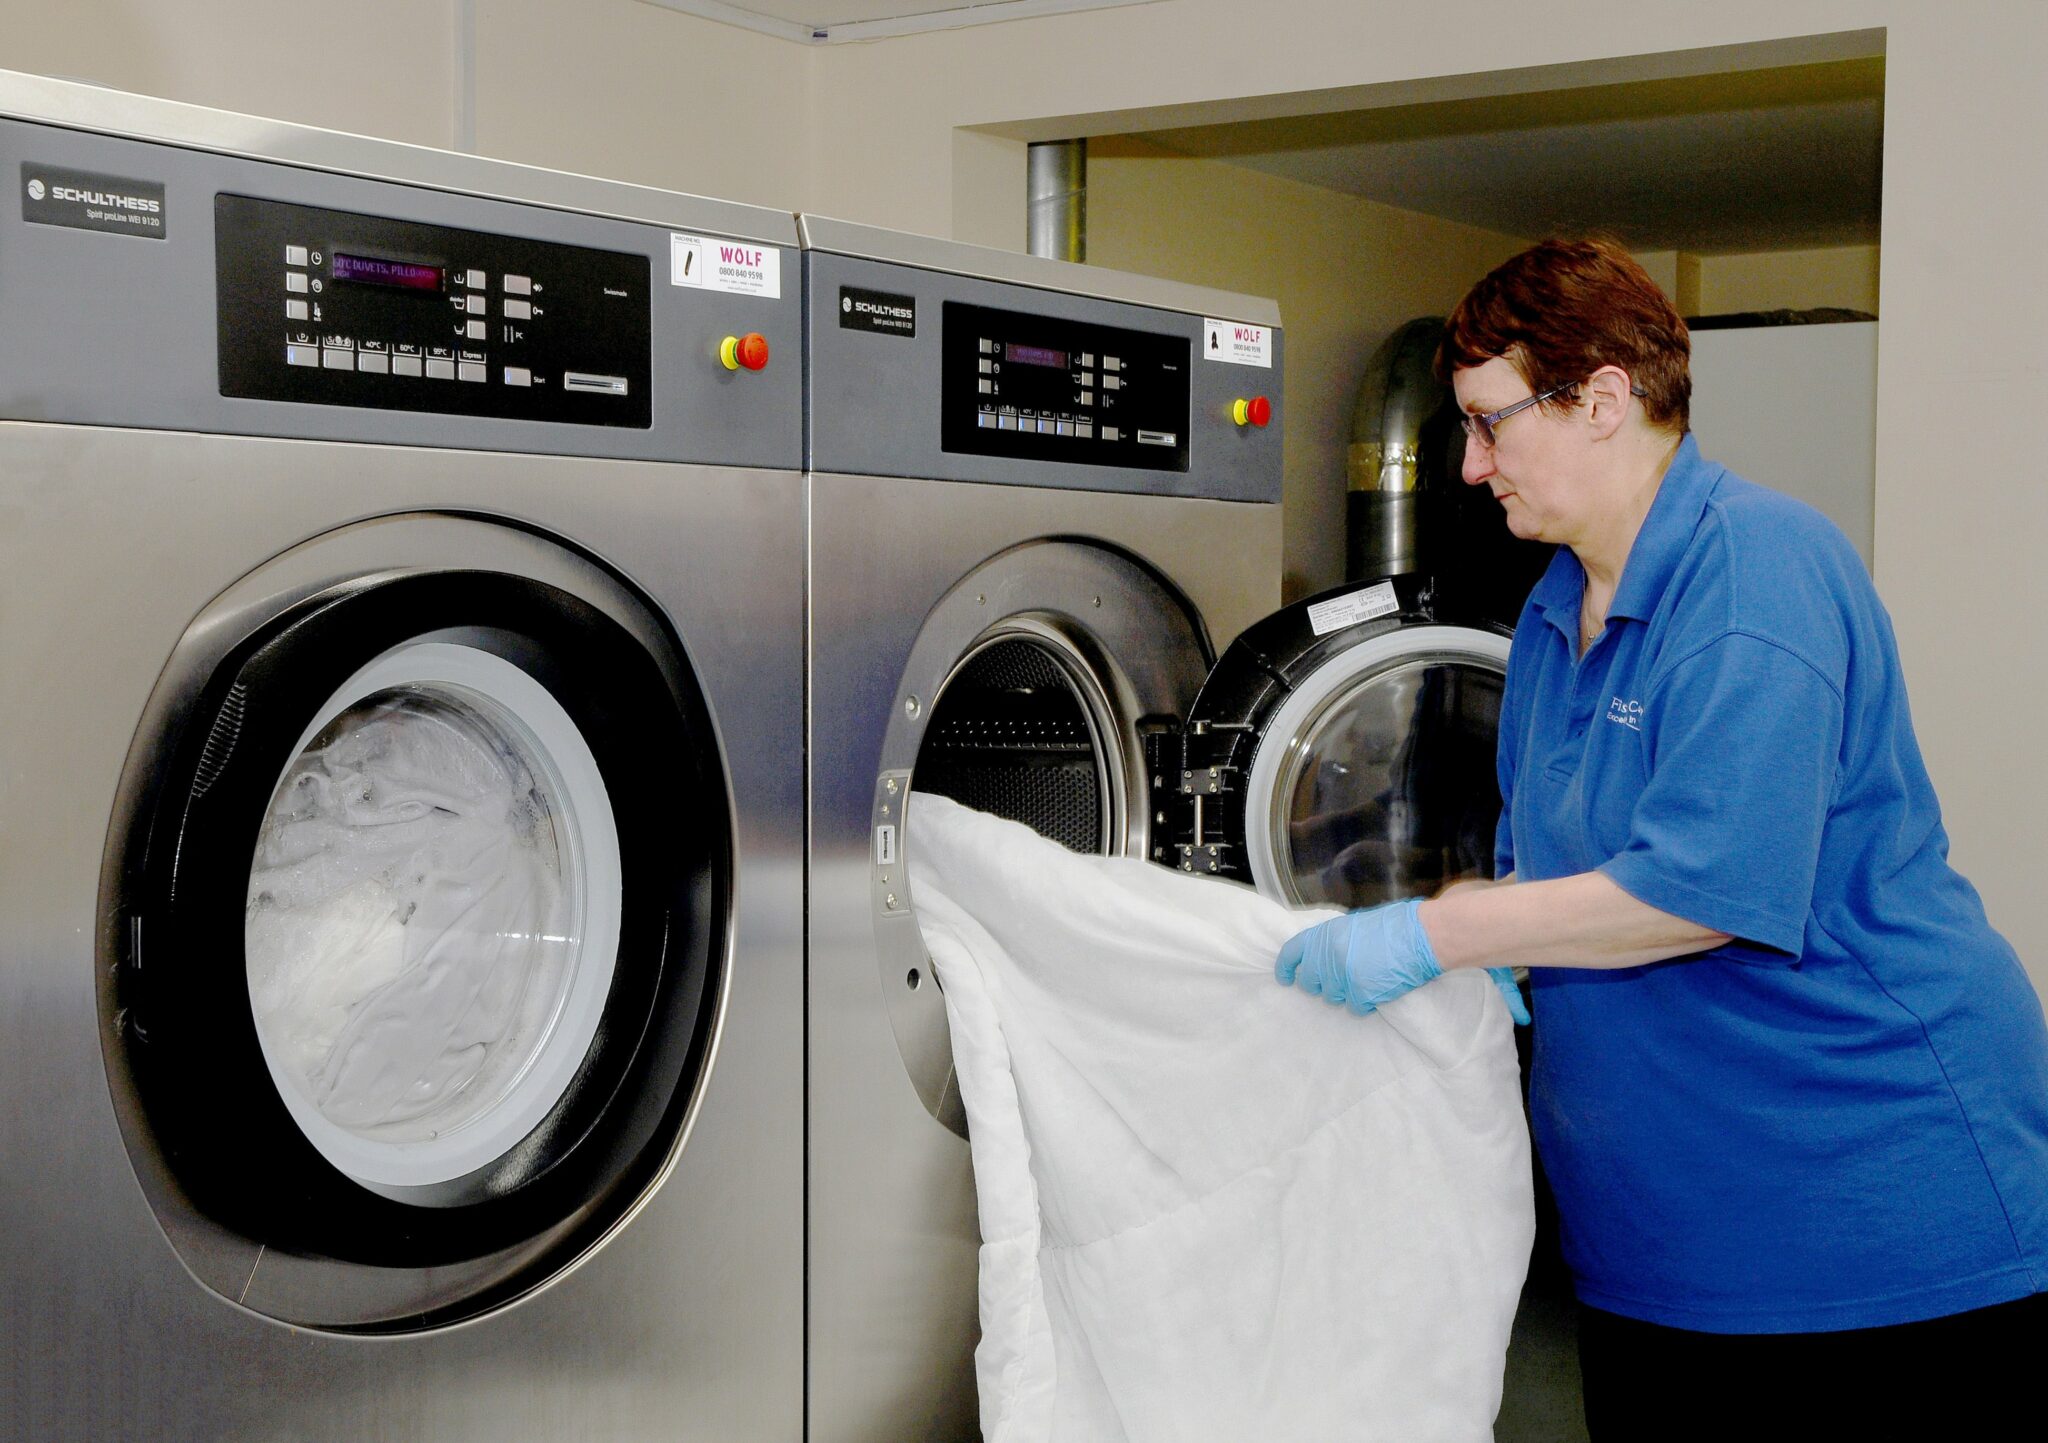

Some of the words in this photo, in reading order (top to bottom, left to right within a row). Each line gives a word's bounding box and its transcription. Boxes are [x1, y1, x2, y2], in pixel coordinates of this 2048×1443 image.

[52, 186, 160, 213] SCHULTHESS
[86, 208, 103, 220] Spirit
[104, 211, 127, 223] proLine
[128, 214, 141, 224] WEI
[141, 216, 160, 226] 9120
[720, 246, 762, 267] WOLF
[719, 266, 735, 276] 0800
[735, 268, 747, 278] 840
[748, 271, 763, 280] 9598
[855, 302, 913, 319] SCHULTHESS
[1234, 327, 1261, 343] WOLF
[462, 350, 482, 359] Express
